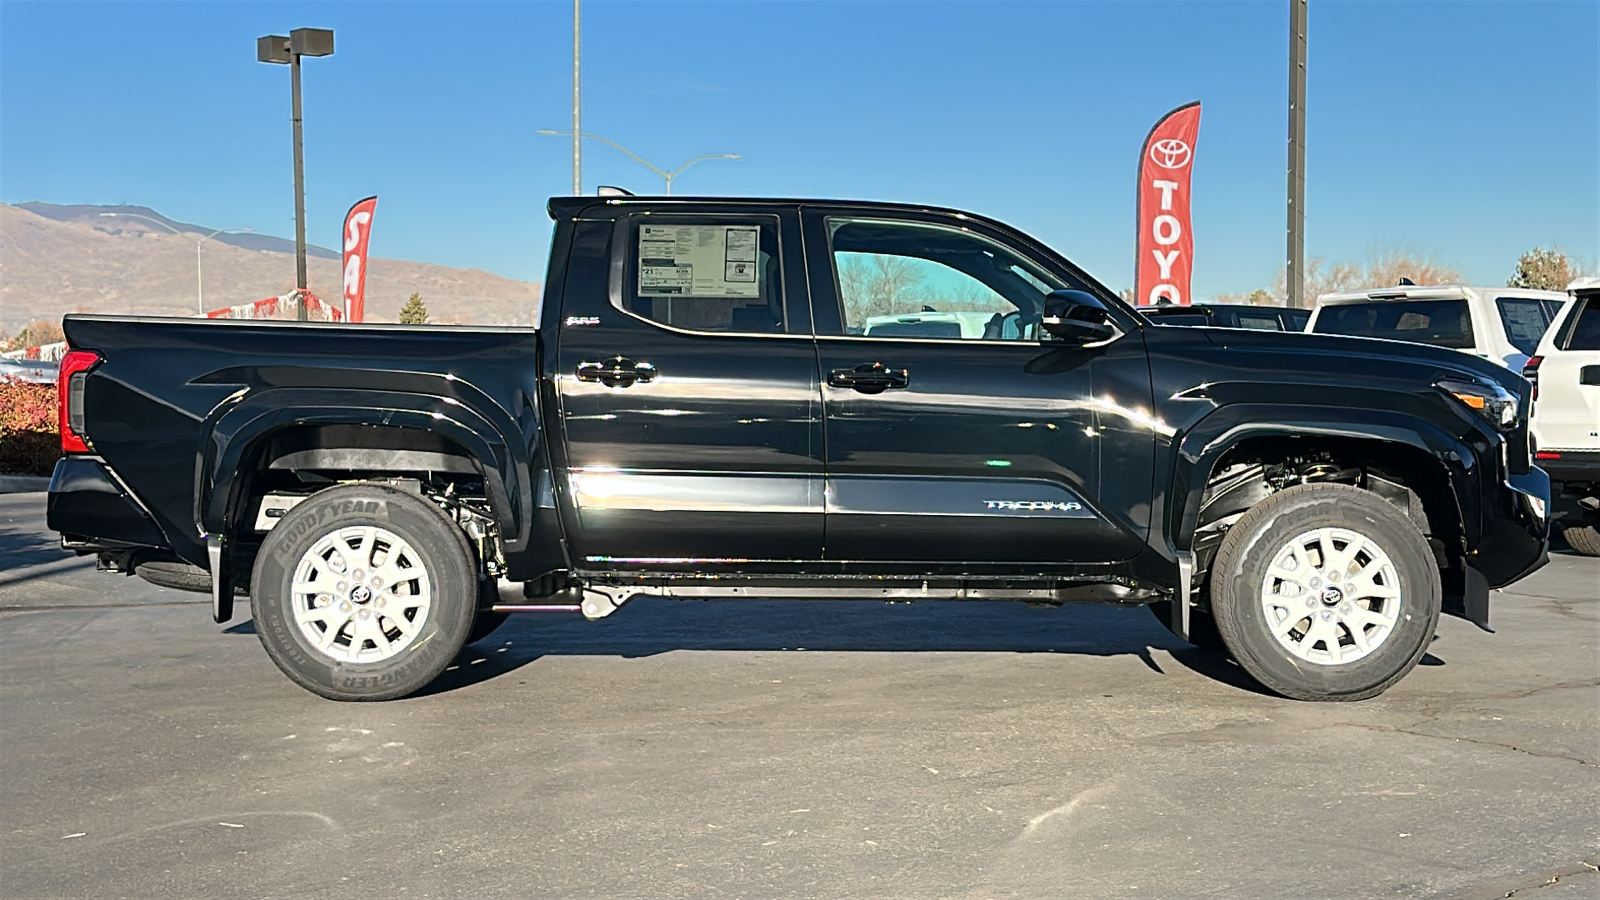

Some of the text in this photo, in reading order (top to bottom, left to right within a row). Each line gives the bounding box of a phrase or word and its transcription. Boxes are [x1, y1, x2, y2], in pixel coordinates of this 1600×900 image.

[1150, 179, 1181, 305] TOYO
[280, 500, 380, 555] GOODYEAR
[983, 500, 1082, 511] TACOMA
